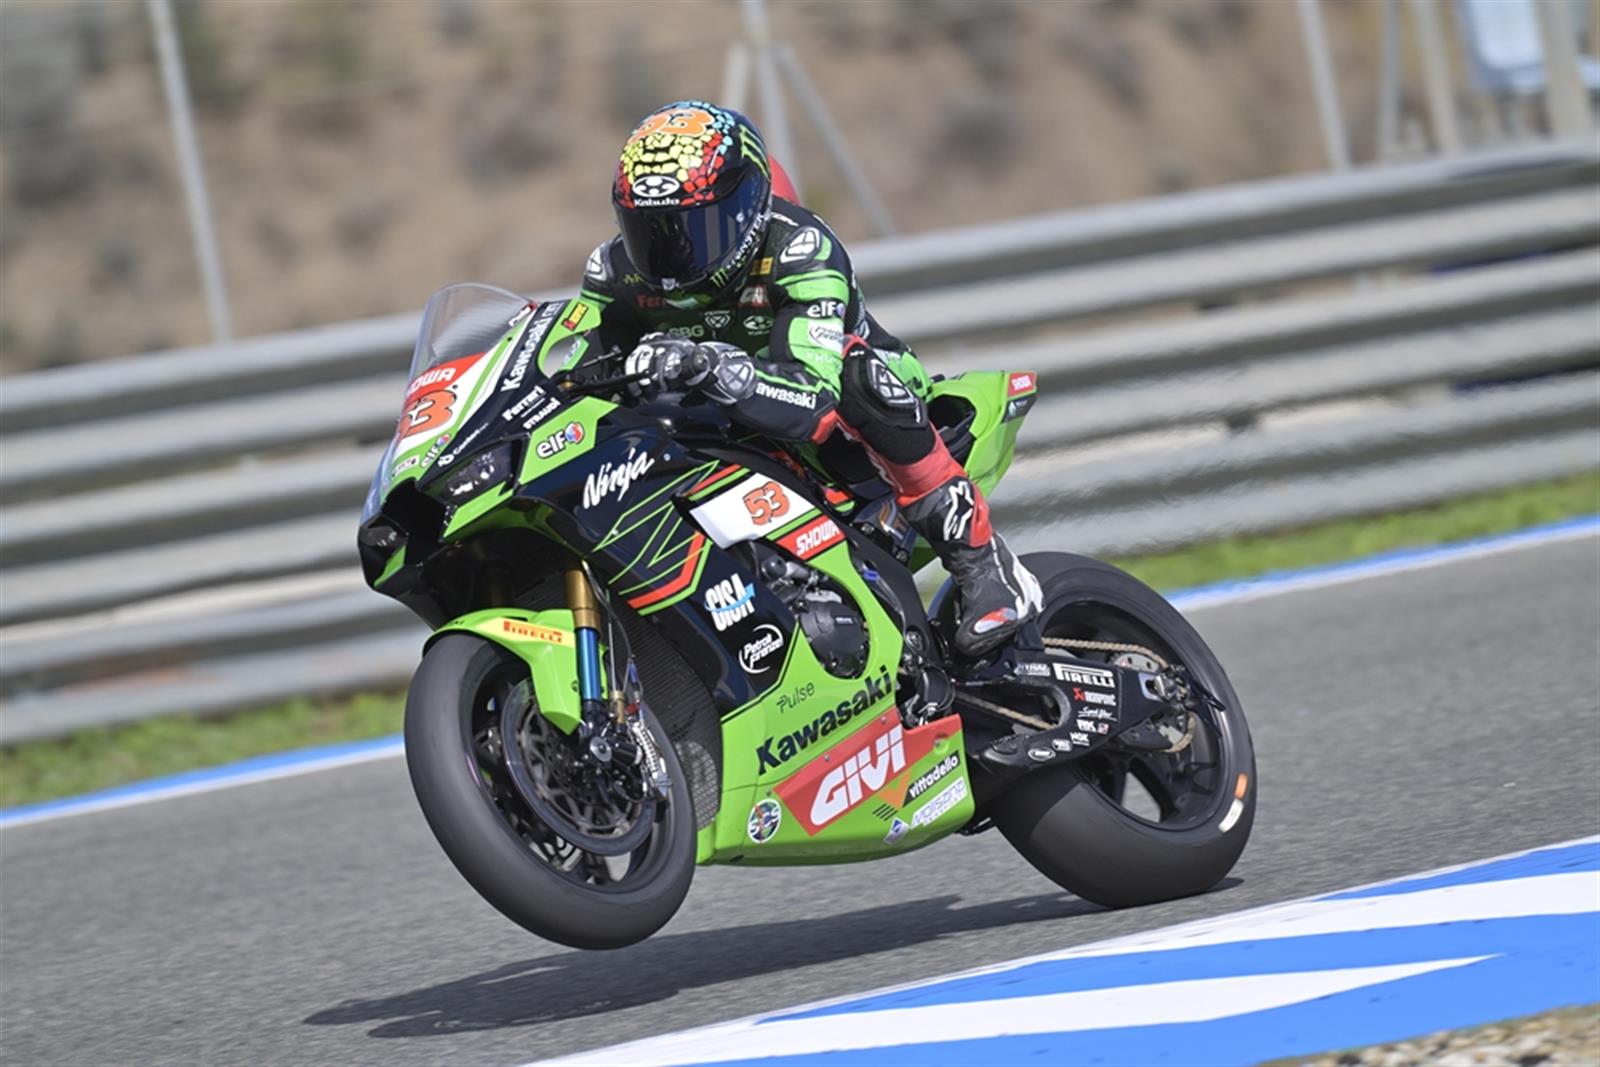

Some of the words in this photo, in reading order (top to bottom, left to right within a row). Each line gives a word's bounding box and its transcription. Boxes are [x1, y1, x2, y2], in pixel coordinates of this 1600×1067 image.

[807, 301, 837, 318] elf
[500, 316, 554, 392] Kawasaki
[755, 382, 817, 409] awasaki
[536, 430, 566, 459] elf
[583, 447, 655, 510] Ninja
[742, 481, 791, 526] 53
[795, 519, 840, 557] SHOWA
[503, 620, 562, 643] PIRELLI
[1052, 663, 1115, 688] PIRELLI
[776, 682, 816, 714] Pulse
[756, 665, 893, 776] Kawasaki
[810, 724, 906, 826] GIVI
[909, 755, 959, 798] vittadello
